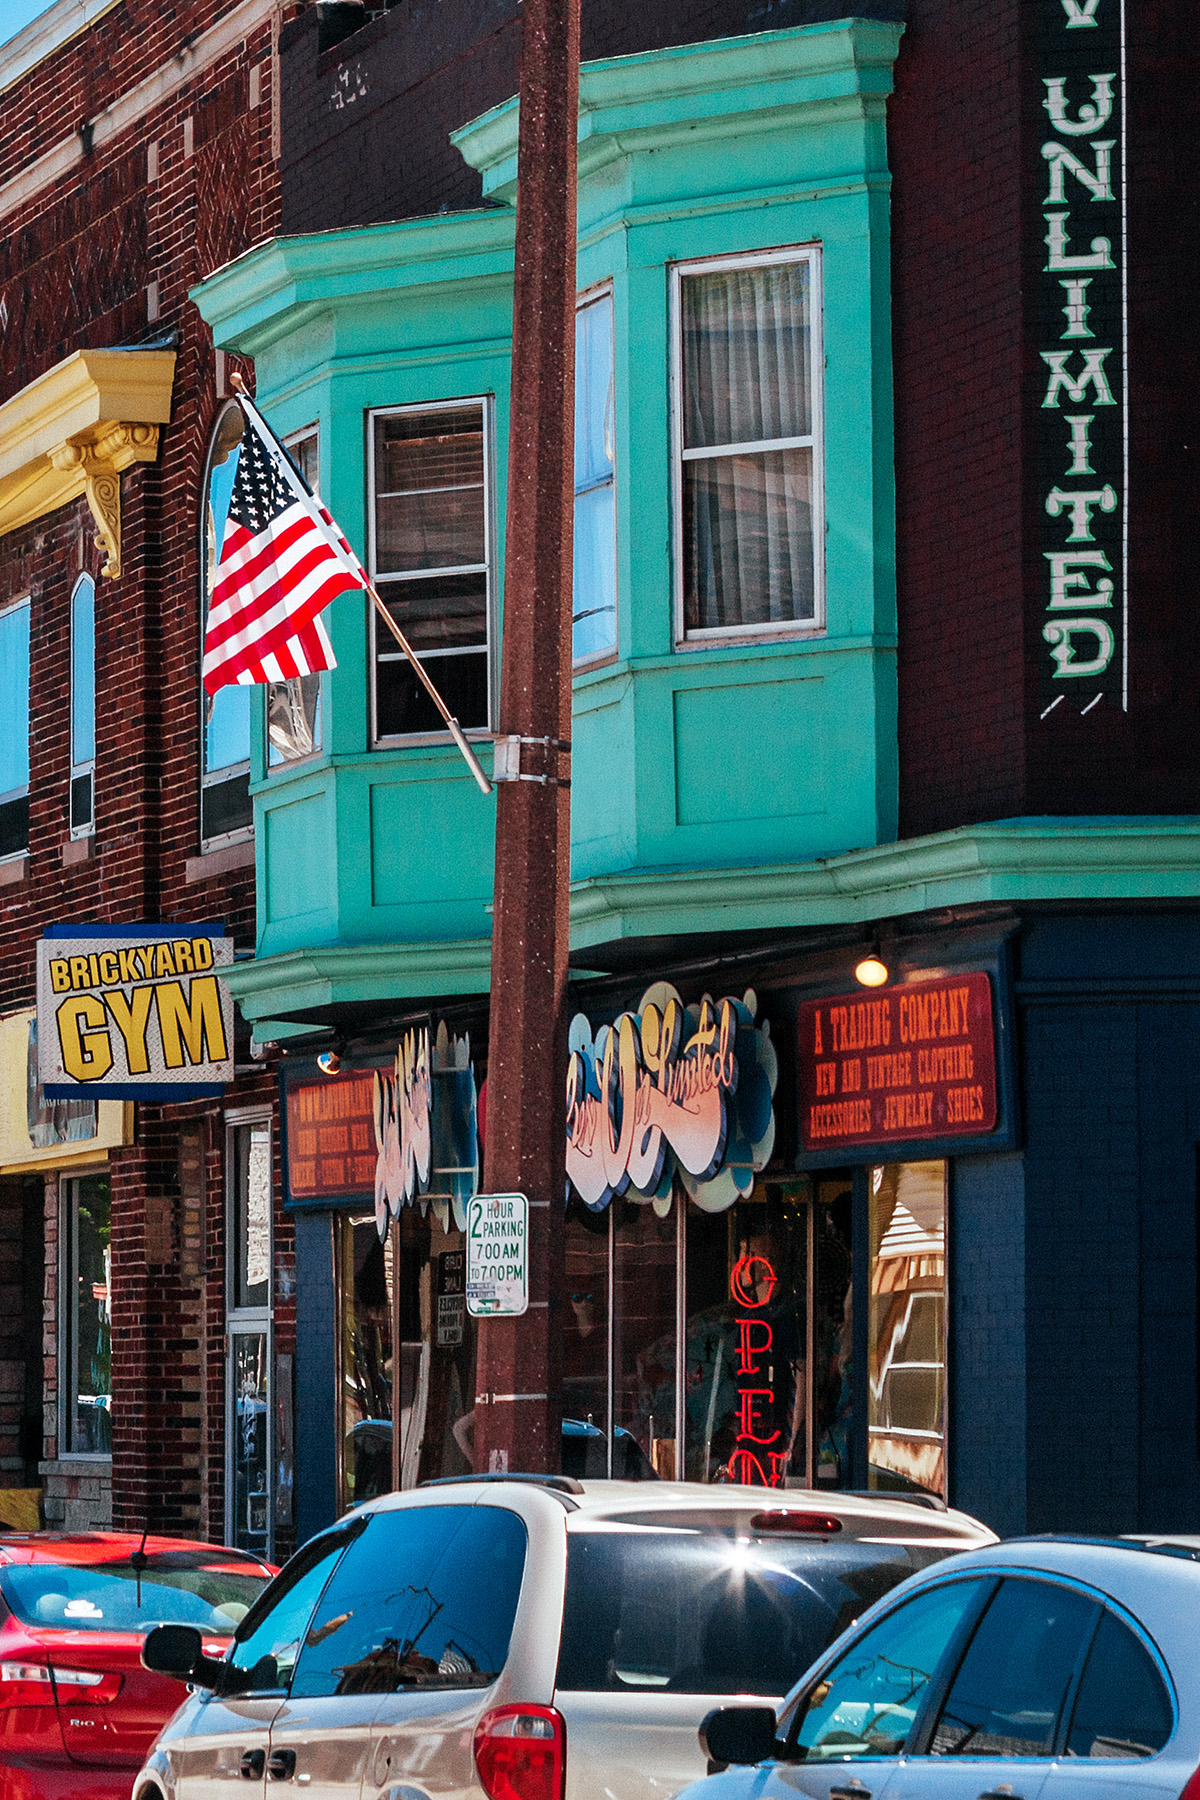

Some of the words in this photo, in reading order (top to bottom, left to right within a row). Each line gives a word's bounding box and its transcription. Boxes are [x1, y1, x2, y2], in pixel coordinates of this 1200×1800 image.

[1039, 73, 1118, 679] UNLIMITED
[50, 937, 215, 994] BRICKYARD
[56, 975, 229, 1083] GYM
[814, 1010, 823, 1054] A
[830, 999, 891, 1052] TRADING
[899, 987, 969, 1043] COMPANY
[867, 1052, 912, 1090] VINTAGE
[918, 1044, 974, 1084] CLOTHING
[810, 1099, 872, 1139] ACCESSORIES
[883, 1092, 934, 1131] JEWELRY
[947, 1085, 984, 1123] SHOES
[471, 1203, 483, 1238] 2
[486, 1202, 514, 1219] HOUR
[483, 1220, 524, 1238] PARKING
[472, 1267, 480, 1279] TO
[729, 1256, 786, 1488] OPEN
